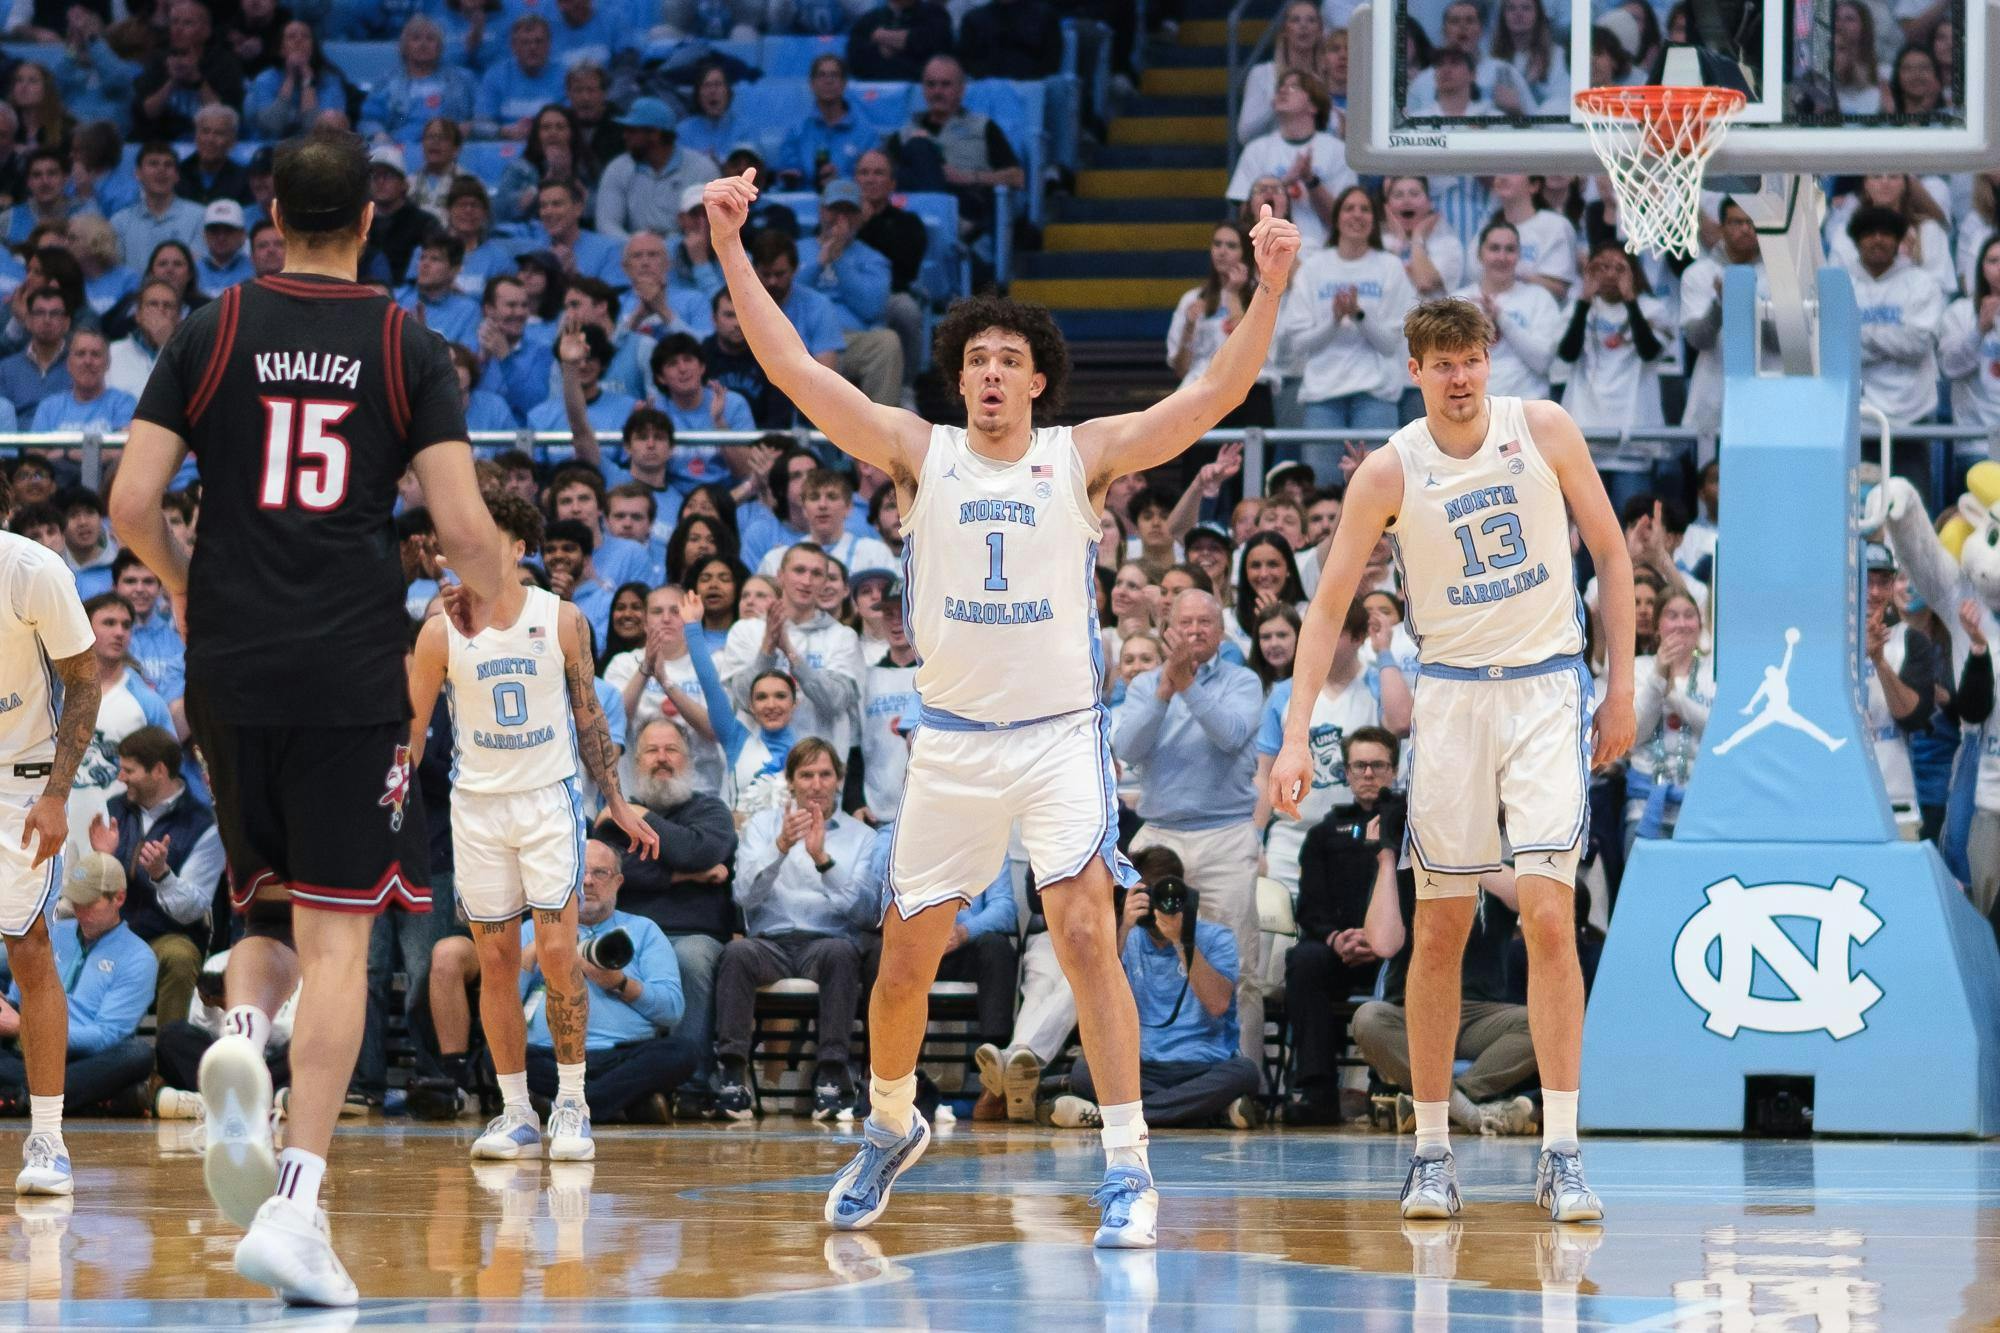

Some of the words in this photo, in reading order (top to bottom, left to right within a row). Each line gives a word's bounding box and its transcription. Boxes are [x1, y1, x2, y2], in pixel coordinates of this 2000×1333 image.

[1388, 134, 1448, 148] SPALDING
[255, 351, 362, 390] KHALIFA
[259, 396, 358, 514] 15
[960, 499, 1036, 527] NORTH
[1444, 485, 1518, 523] NORTH
[984, 532, 1008, 591] 1
[1454, 511, 1528, 577] 13
[1446, 562, 1550, 606] CAROLINA
[944, 596, 1054, 624] CAROLINA
[477, 657, 538, 681] NORTH
[492, 681, 529, 727] 0
[473, 724, 556, 750] CAROLINA
[1315, 730, 1339, 746] UNC
